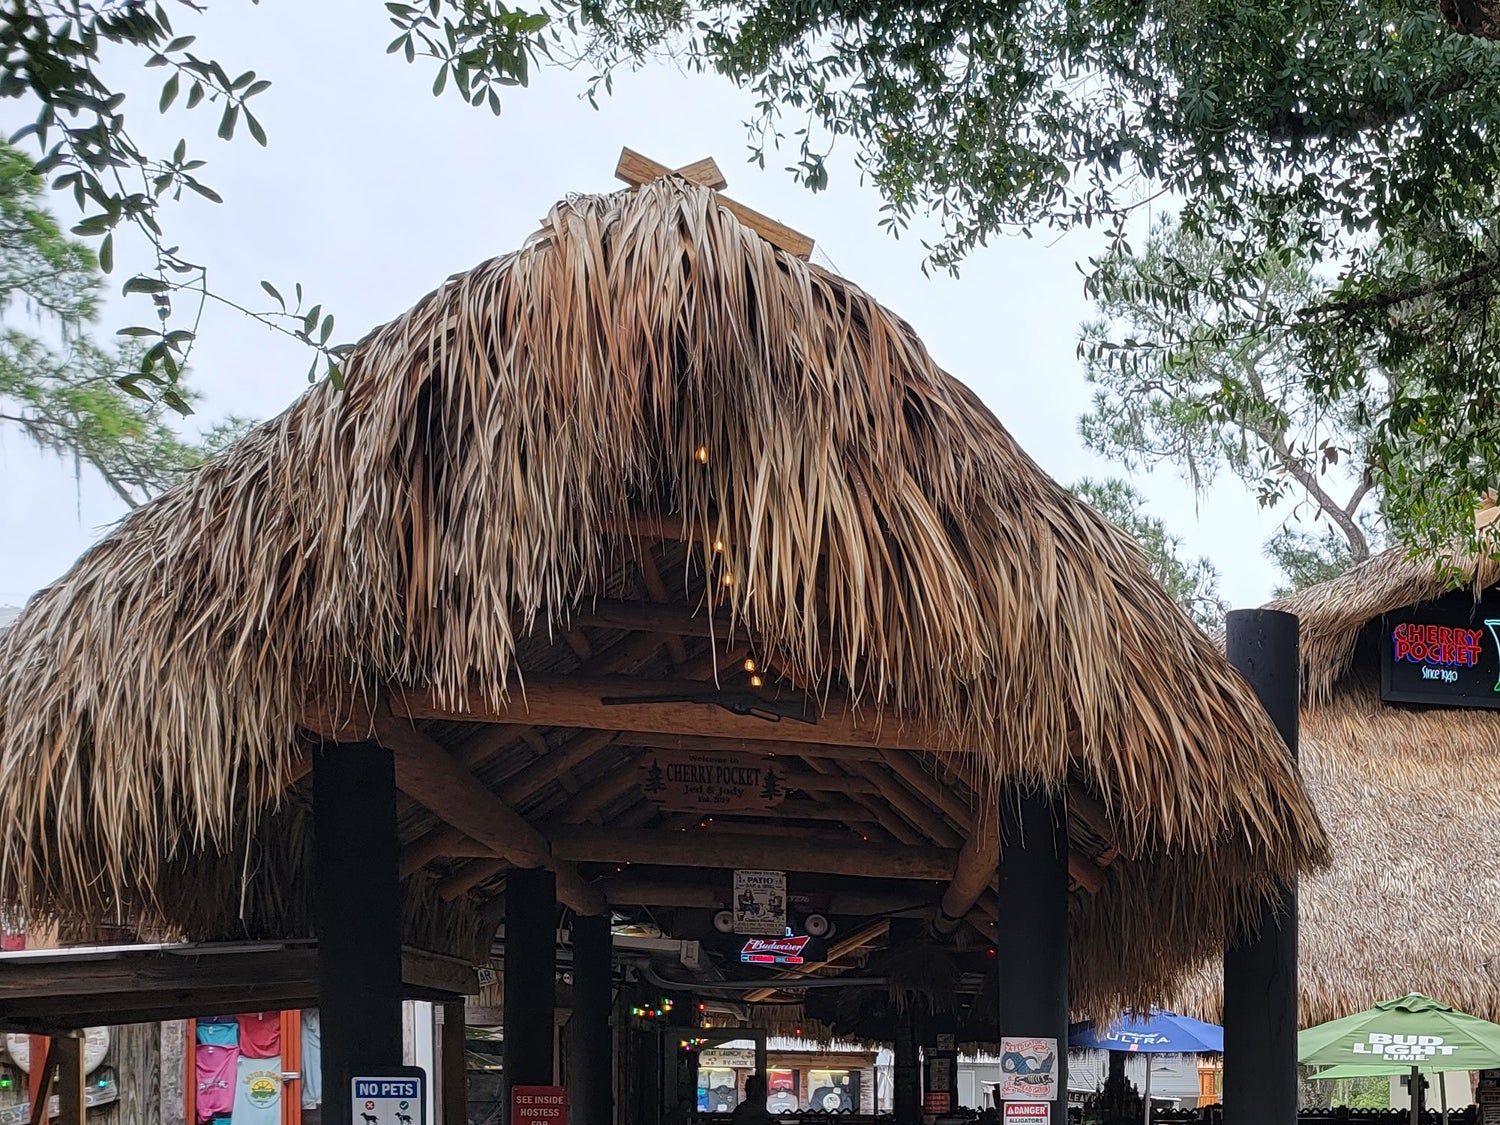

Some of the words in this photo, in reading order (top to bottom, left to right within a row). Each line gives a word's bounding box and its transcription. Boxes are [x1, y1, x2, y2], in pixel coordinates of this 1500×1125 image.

[1393, 623, 1483, 646] CHERRY
[1395, 640, 1482, 665] POCKET
[667, 763, 713, 783] CHERRY
[716, 766, 761, 786] POCKET
[750, 939, 802, 951] Budweiser
[1106, 1032, 1169, 1044] ULTRA
[1369, 1033, 1444, 1046] BUD
[1353, 1043, 1459, 1055] LIGHT
[360, 1083, 378, 1095] NO
[382, 1083, 413, 1096] PETS
[516, 1096, 533, 1104] SEE
[535, 1096, 564, 1104] INSIDE
[520, 1109, 560, 1117] HOSTESS
[1014, 1106, 1046, 1115] DANGER
